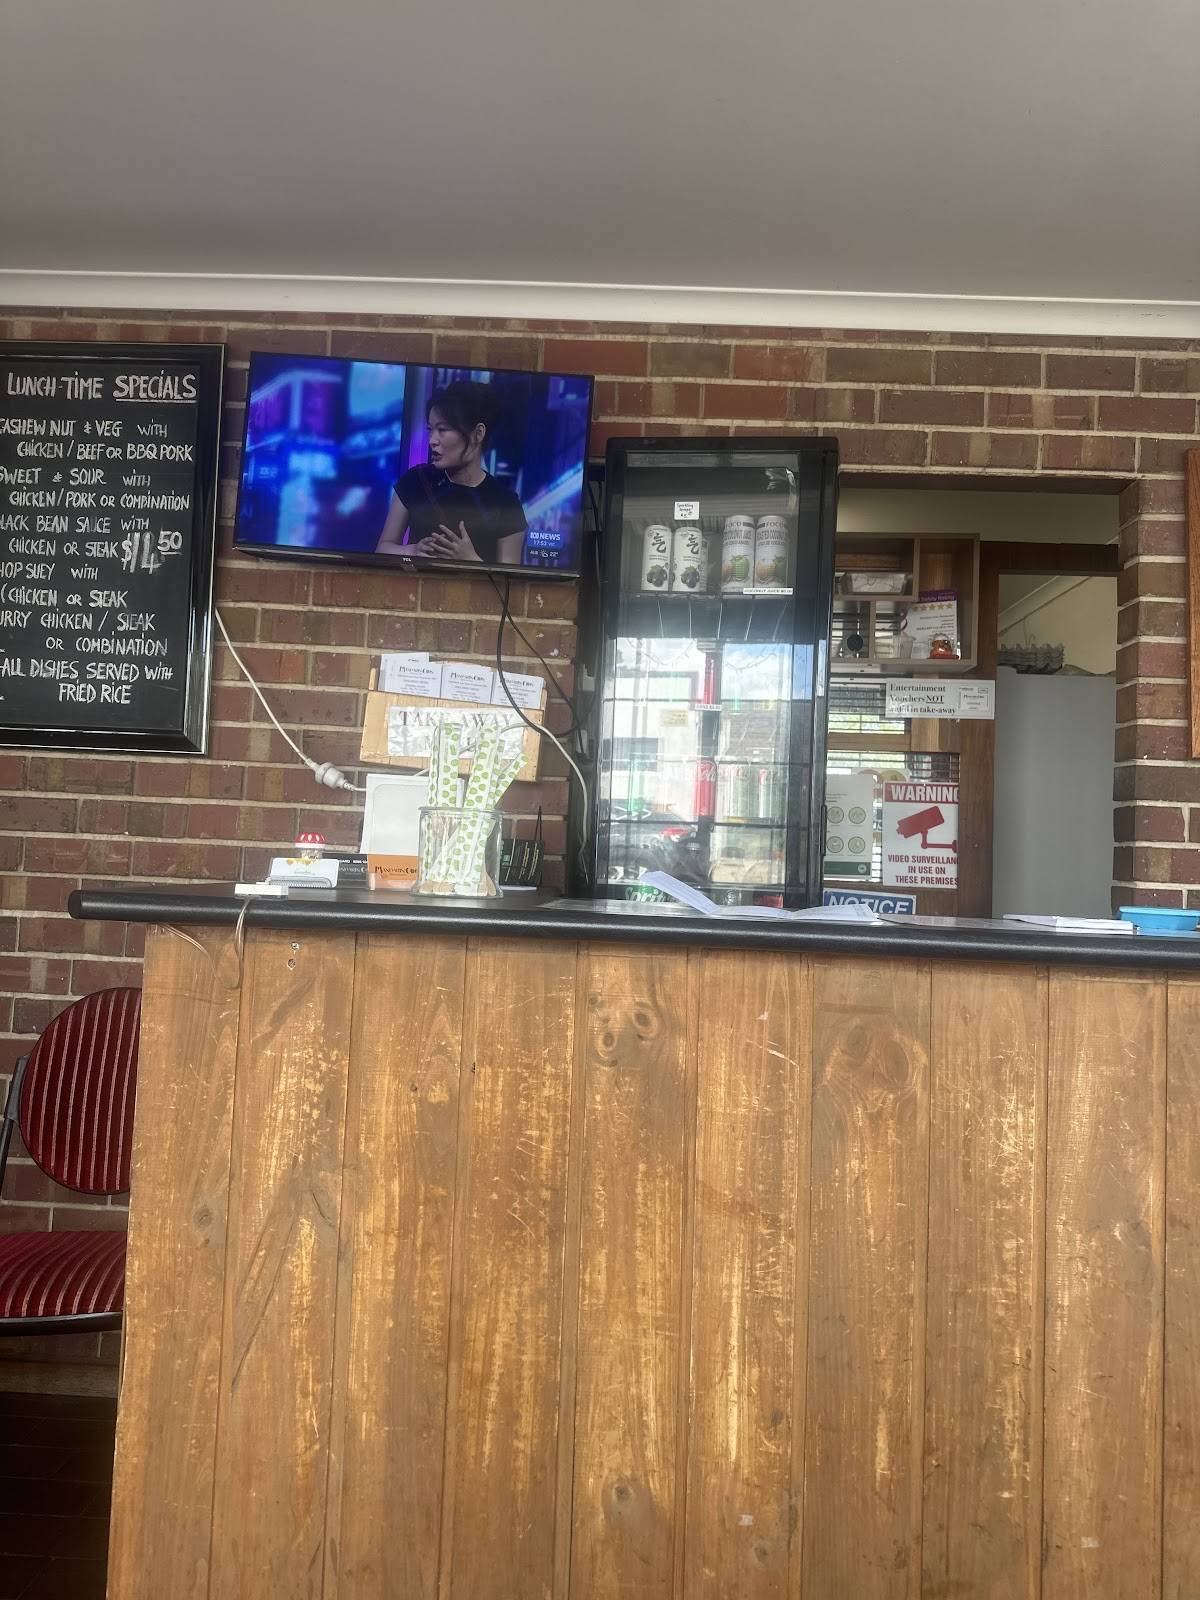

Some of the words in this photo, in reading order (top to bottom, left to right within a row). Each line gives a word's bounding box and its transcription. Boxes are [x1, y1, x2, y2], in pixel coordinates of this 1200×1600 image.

[113, 370, 197, 402] SPECIALS
[50, 420, 76, 436] NUT
[95, 420, 123, 437] VEG
[127, 443, 157, 460] BBQ
[159, 445, 193, 461] PORK
[69, 468, 106, 485] SOUR
[100, 494, 115, 508] OR
[120, 490, 190, 510] COMBINATION
[0, 514, 29, 532] LACK
[36, 516, 69, 533] BEAN
[540, 532, 561, 541] NEWS
[8, 536, 56, 557] CHICKEN
[64, 542, 79, 555] OR
[85, 540, 119, 558] STEAK
[0, 562, 23, 579] HOP
[25, 563, 55, 581] SUEY
[67, 594, 82, 606] OR
[89, 590, 128, 608] STEAK
[0, 610, 32, 629] URRY
[40, 608, 93, 630] CHICKEN
[117, 612, 156, 631] STEAK
[46, 637, 64, 650] OR
[75, 631, 168, 656] COMBINATION
[29, 658, 79, 680] DISHES
[86, 662, 139, 682] SERVED
[58, 679, 96, 704] FRIED
[100, 682, 132, 704] RICE
[889, 684, 946, 692] Entertainment
[926, 695, 945, 704] NOT
[920, 706, 956, 716] take-away
[887, 854, 909, 863] VIDEO
[911, 855, 959, 865] SURVEILLAN
[908, 866, 916, 874] IN
[918, 866, 931, 875] USE
[935, 867, 946, 875] ON
[896, 876, 919, 885] THESE
[920, 877, 959, 886] PREMISES
[625, 886, 668, 903] Sprit
